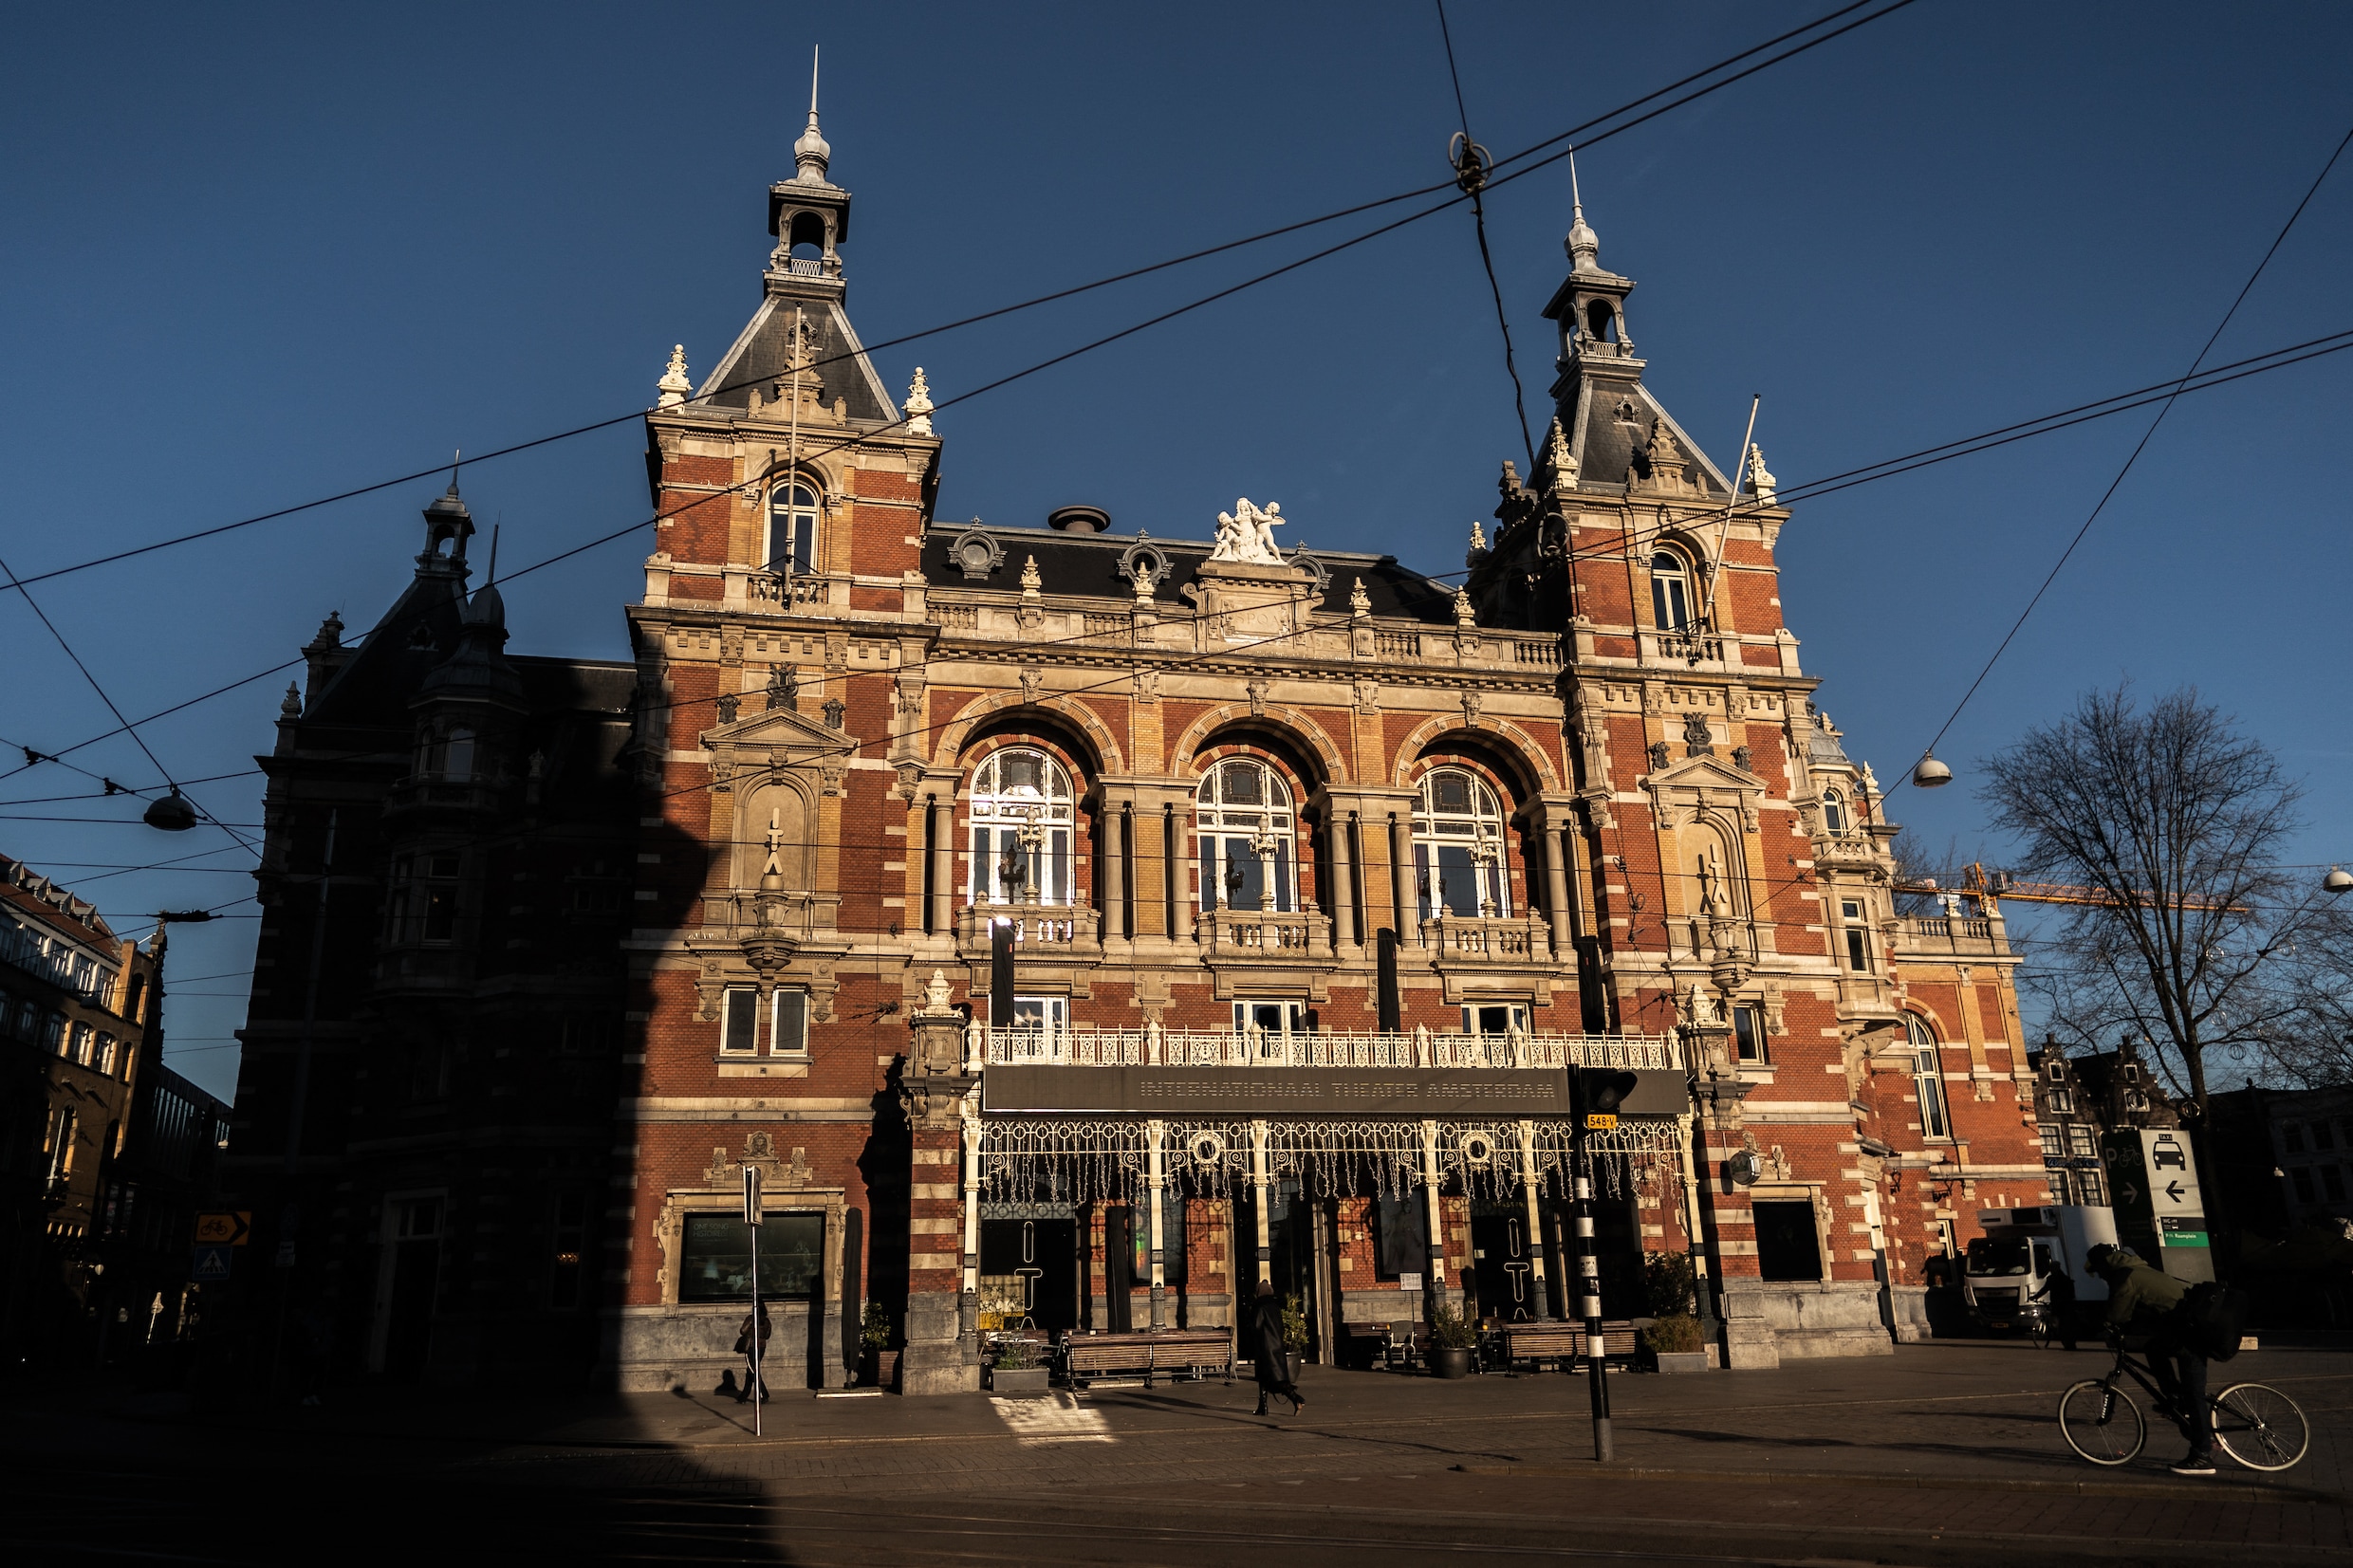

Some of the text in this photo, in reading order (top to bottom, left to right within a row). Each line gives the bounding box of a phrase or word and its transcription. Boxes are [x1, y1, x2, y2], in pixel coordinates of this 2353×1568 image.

[763, 807, 784, 874] ITA
[1710, 842, 1730, 904] ITA
[1140, 1081, 1555, 1098] INTERNATIONAAL THEATER AMSTERDAM
[2104, 1147, 2118, 1169] P
